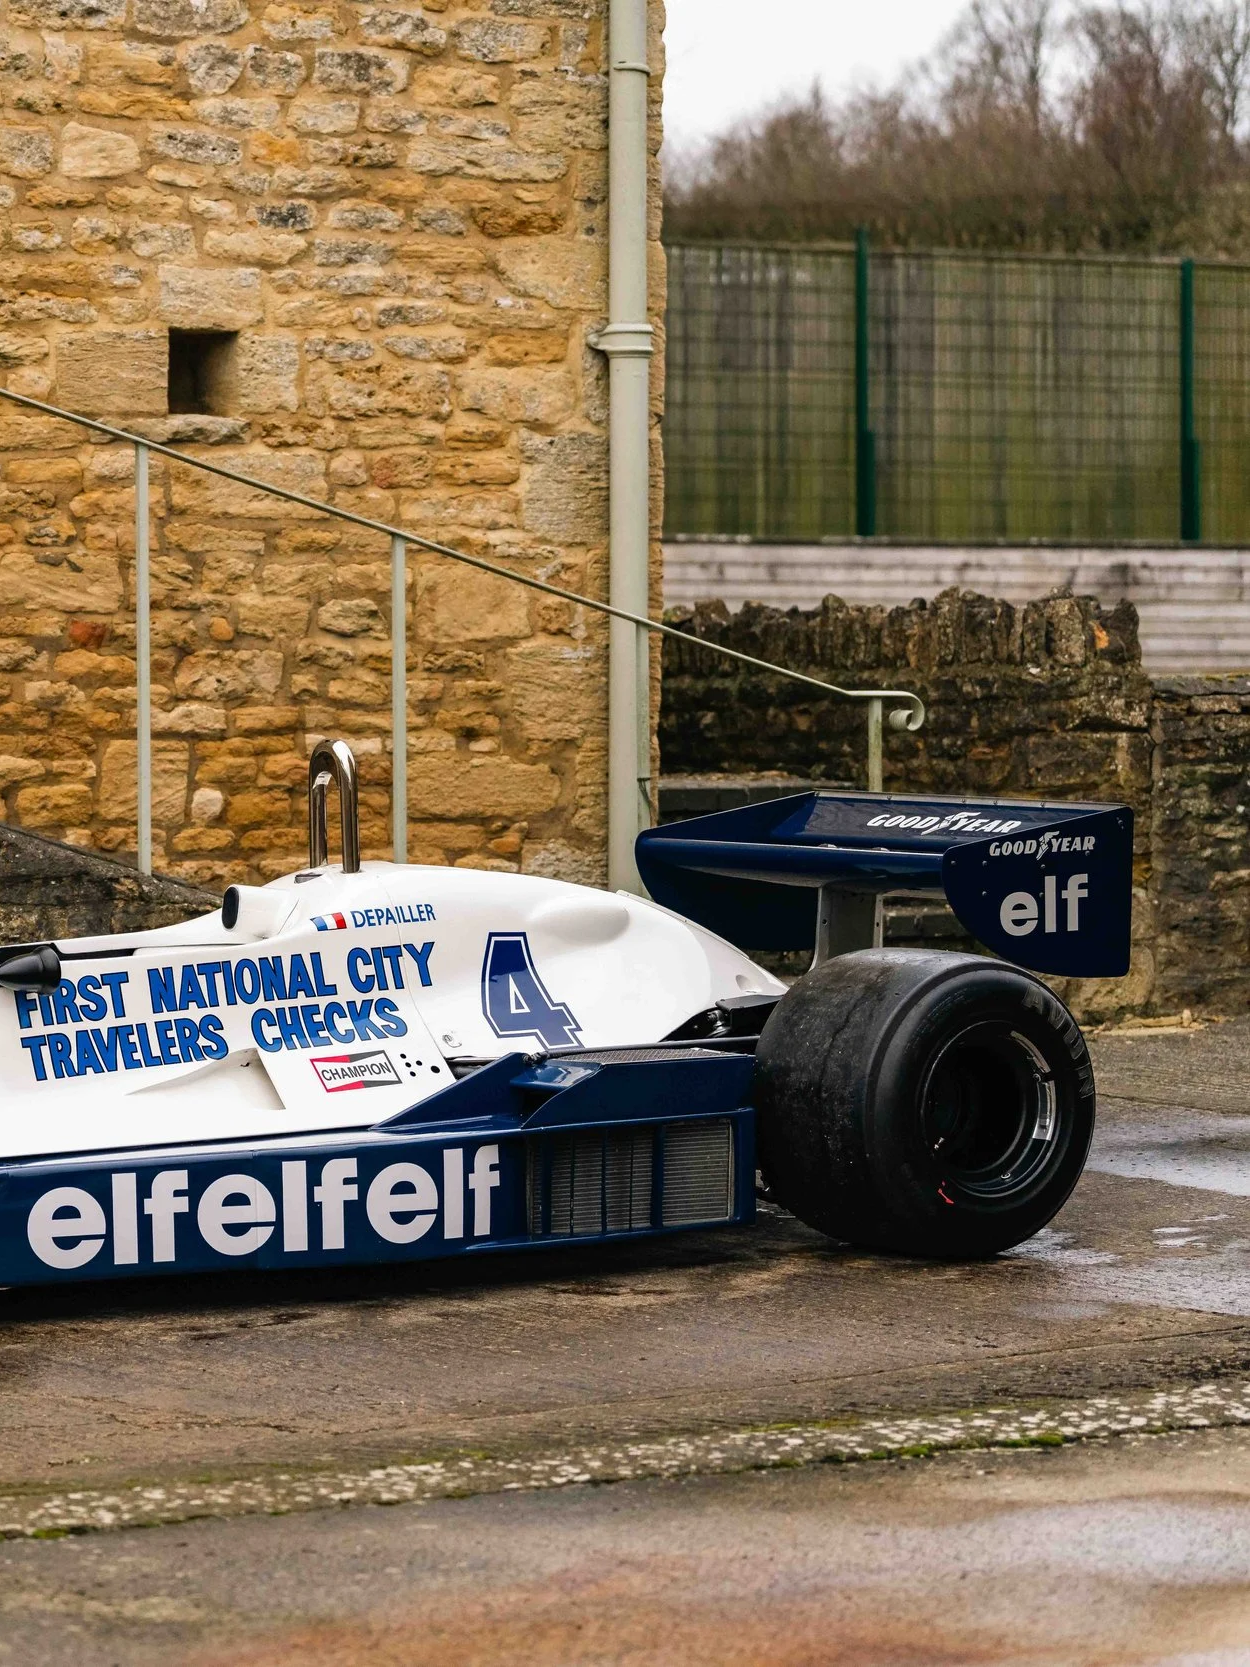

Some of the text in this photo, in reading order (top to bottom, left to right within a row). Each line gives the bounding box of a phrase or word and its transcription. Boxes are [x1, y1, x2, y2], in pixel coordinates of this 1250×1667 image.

[350, 903, 436, 928] DEPAILLER
[999, 873, 1089, 937] elf
[15, 941, 436, 1030] FIRST NATIONAL CITY
[481, 931, 585, 1050] 4
[20, 997, 409, 1082] TRAVELERS CHECKS
[321, 1061, 391, 1083] CHAMPION
